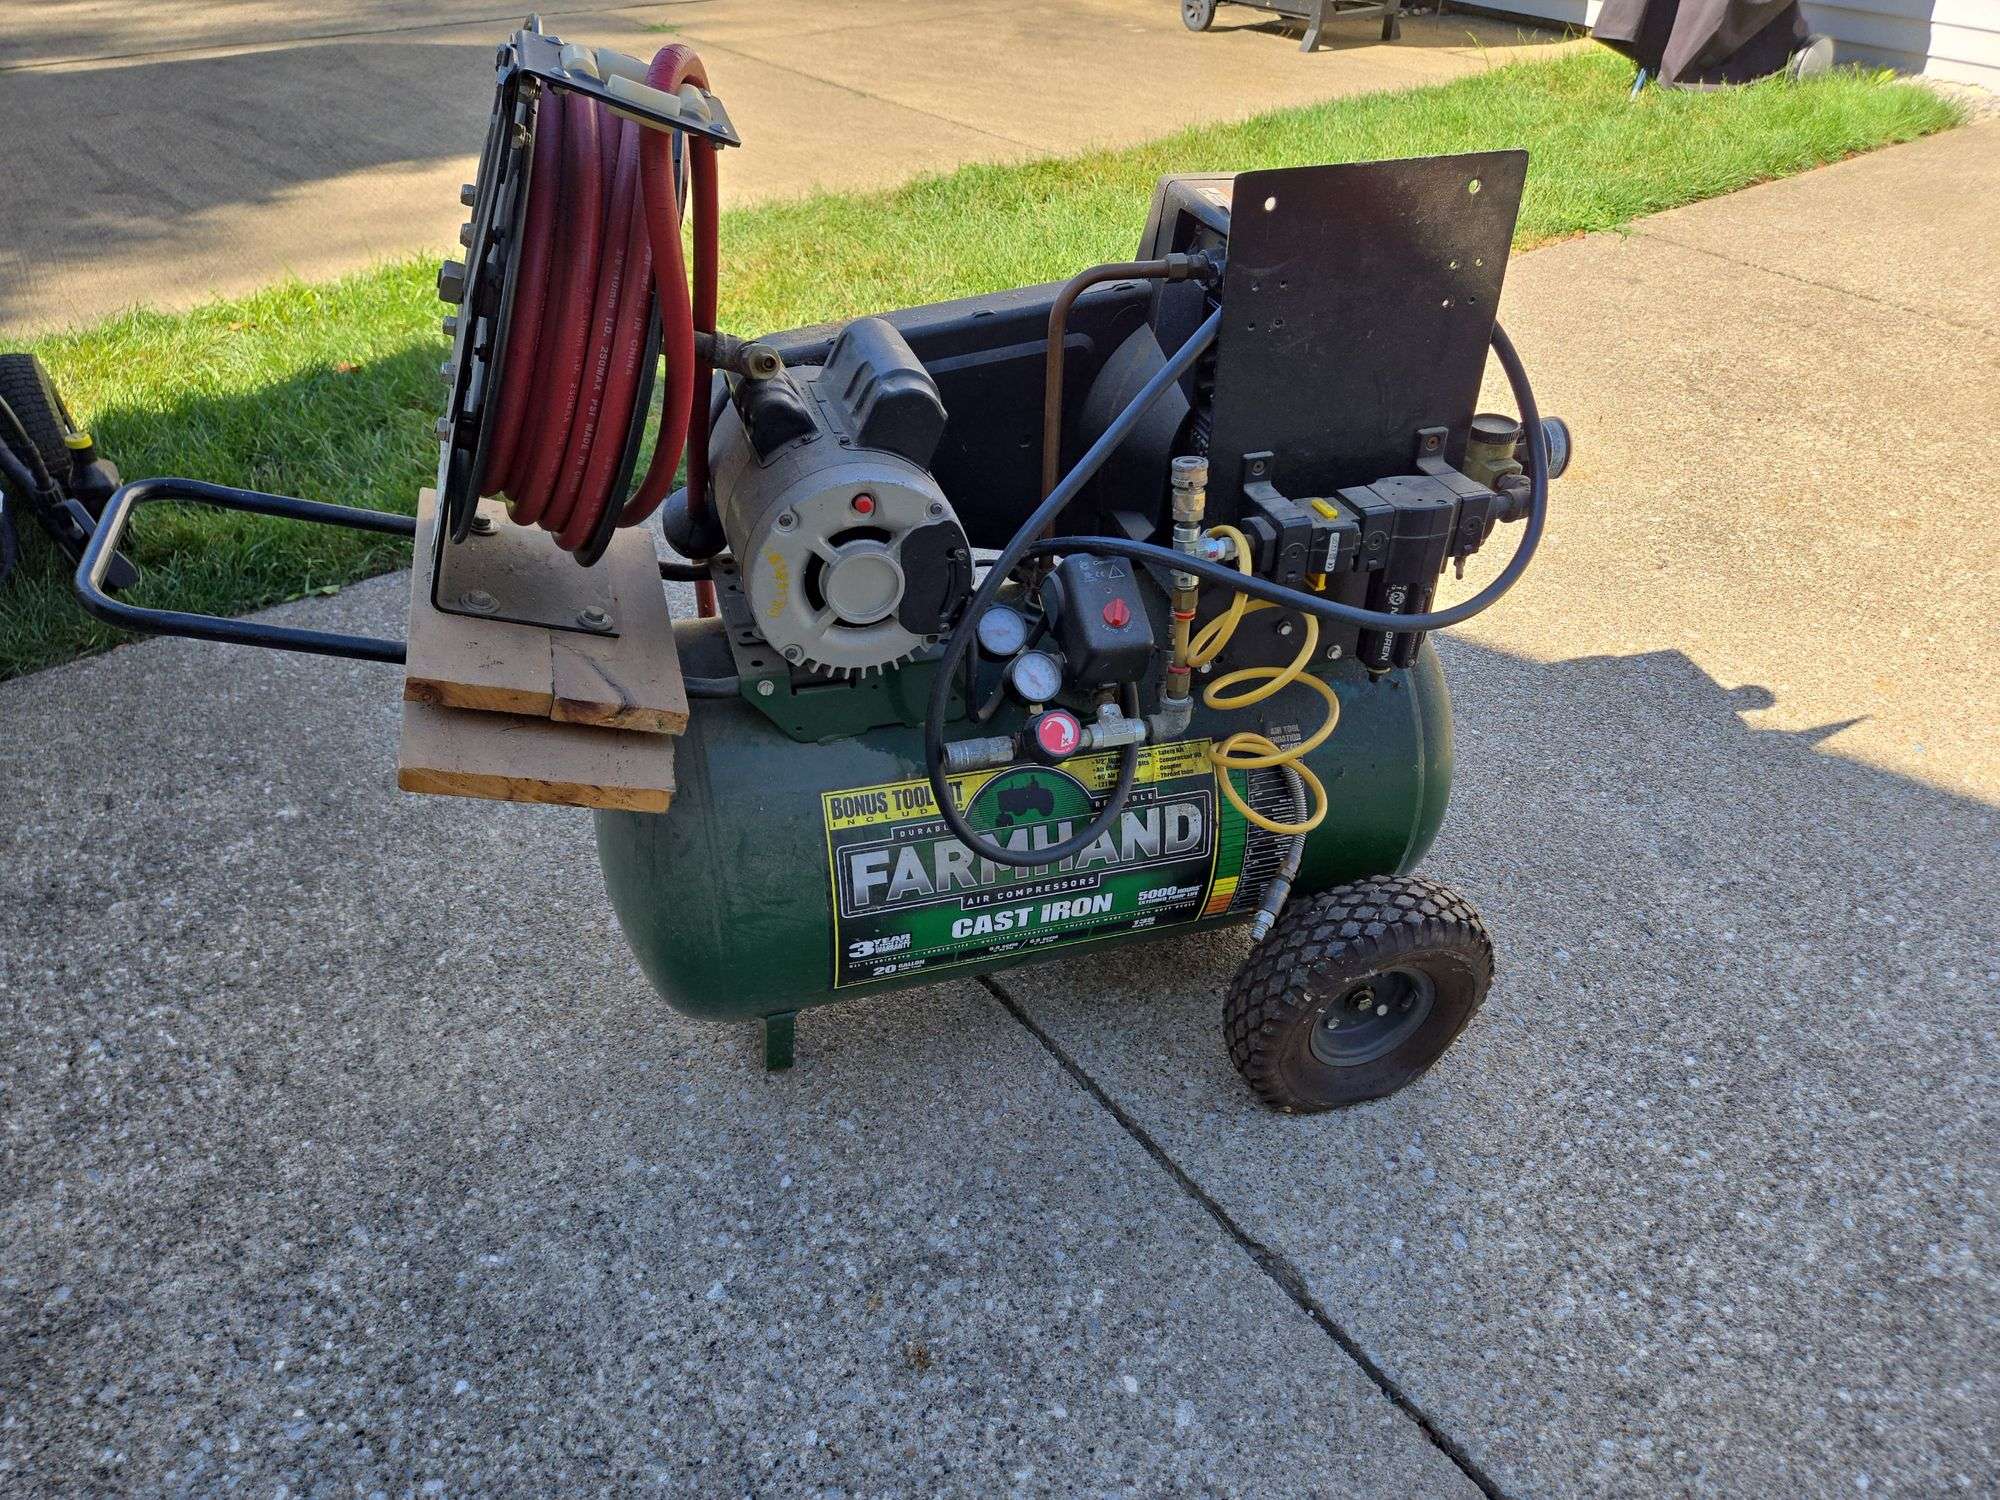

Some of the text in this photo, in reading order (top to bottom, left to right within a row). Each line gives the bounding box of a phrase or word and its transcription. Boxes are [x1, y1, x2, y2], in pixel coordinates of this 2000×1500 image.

[592, 345, 609, 391] 250MAX
[624, 339, 639, 375] CHINA
[588, 398, 599, 416] PSI
[581, 423, 594, 450] MADE
[1381, 606, 1399, 661] NGREN
[831, 791, 889, 821] BONUS
[892, 785, 935, 811] TOOL
[833, 802, 963, 828] INCLUDD
[899, 823, 950, 838] DURABL
[849, 801, 1202, 906] FARMHAND
[967, 876, 1096, 906] AIR COMPRESSORS
[1138, 886, 1178, 901] 5000
[951, 893, 1113, 939] CAST IRON
[849, 933, 911, 958] 3 YEAR
[873, 964, 897, 977] 20
[898, 959, 925, 969] GALLON
